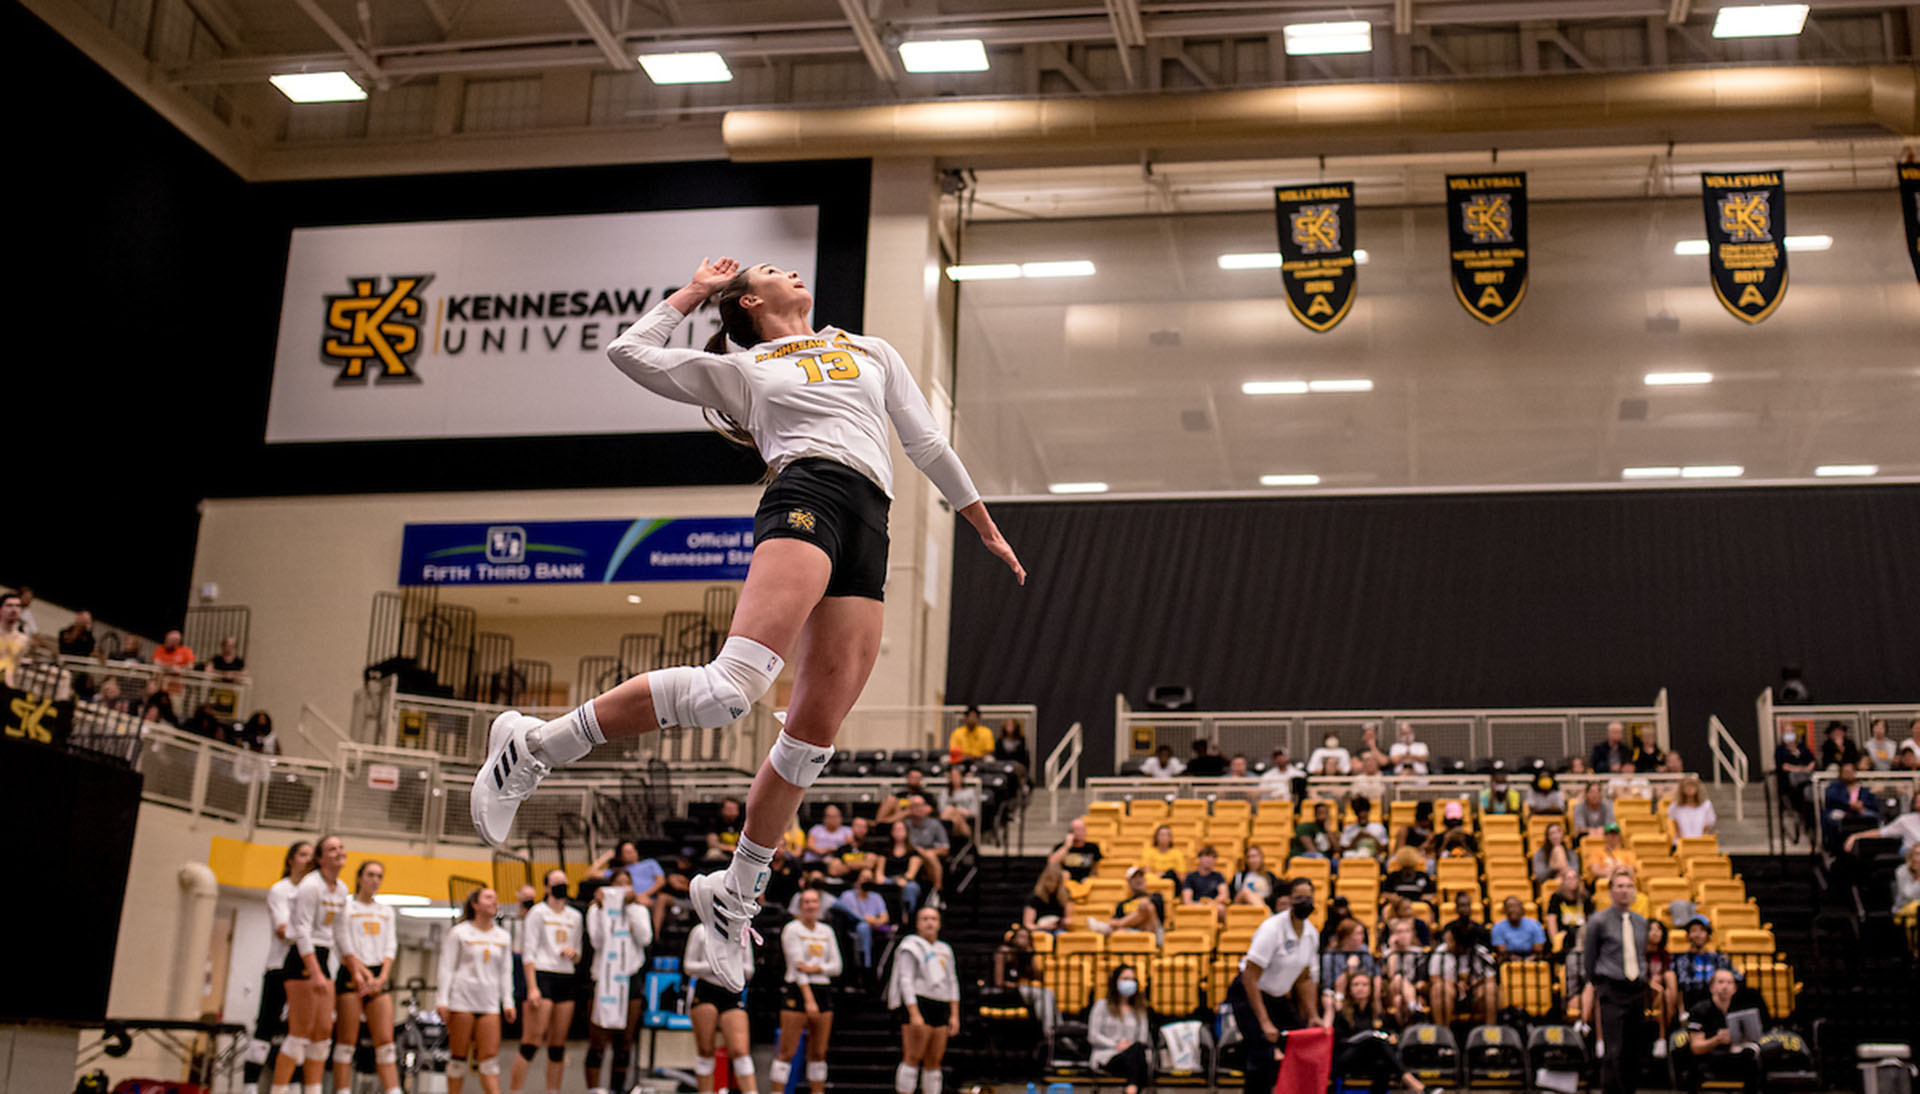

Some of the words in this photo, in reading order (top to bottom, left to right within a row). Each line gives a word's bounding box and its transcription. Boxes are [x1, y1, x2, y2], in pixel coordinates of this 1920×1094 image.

[1449, 176, 1523, 190] VOLLEYBALL
[1704, 173, 1780, 188] VOLLEYBALL
[447, 289, 651, 322] KENNESAW
[795, 351, 860, 383] 13
[686, 532, 741, 549] Official
[650, 551, 725, 566] Kennesaw
[727, 549, 753, 565] Sta
[422, 565, 471, 581] FIFTH
[477, 563, 531, 580] THIRD
[535, 562, 585, 579] BANK
